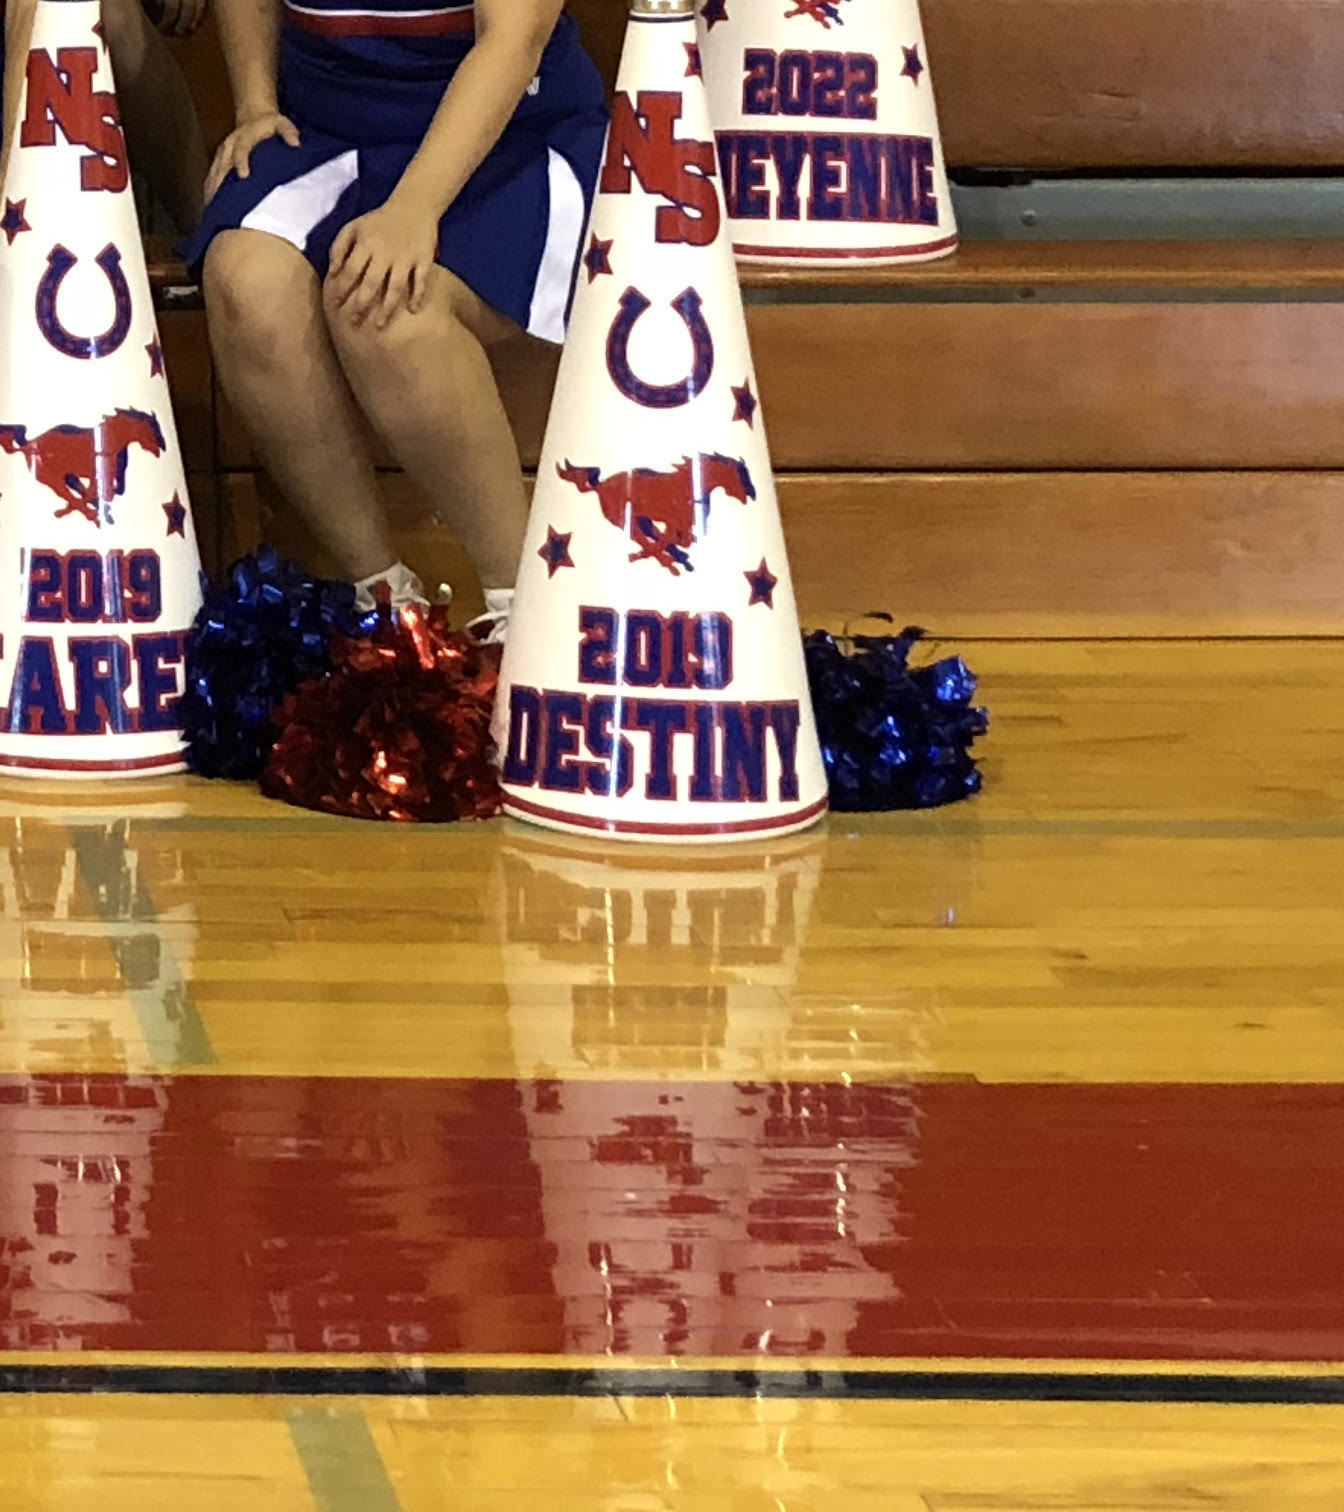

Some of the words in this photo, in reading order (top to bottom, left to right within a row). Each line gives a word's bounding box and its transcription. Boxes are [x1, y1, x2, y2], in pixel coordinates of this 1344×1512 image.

[20, 46, 131, 194] NS
[740, 47, 879, 121] 2022
[599, 89, 721, 247] NS
[20, 546, 163, 624] 2019
[576, 603, 734, 691] 2019
[502, 683, 802, 803] DESTINY
